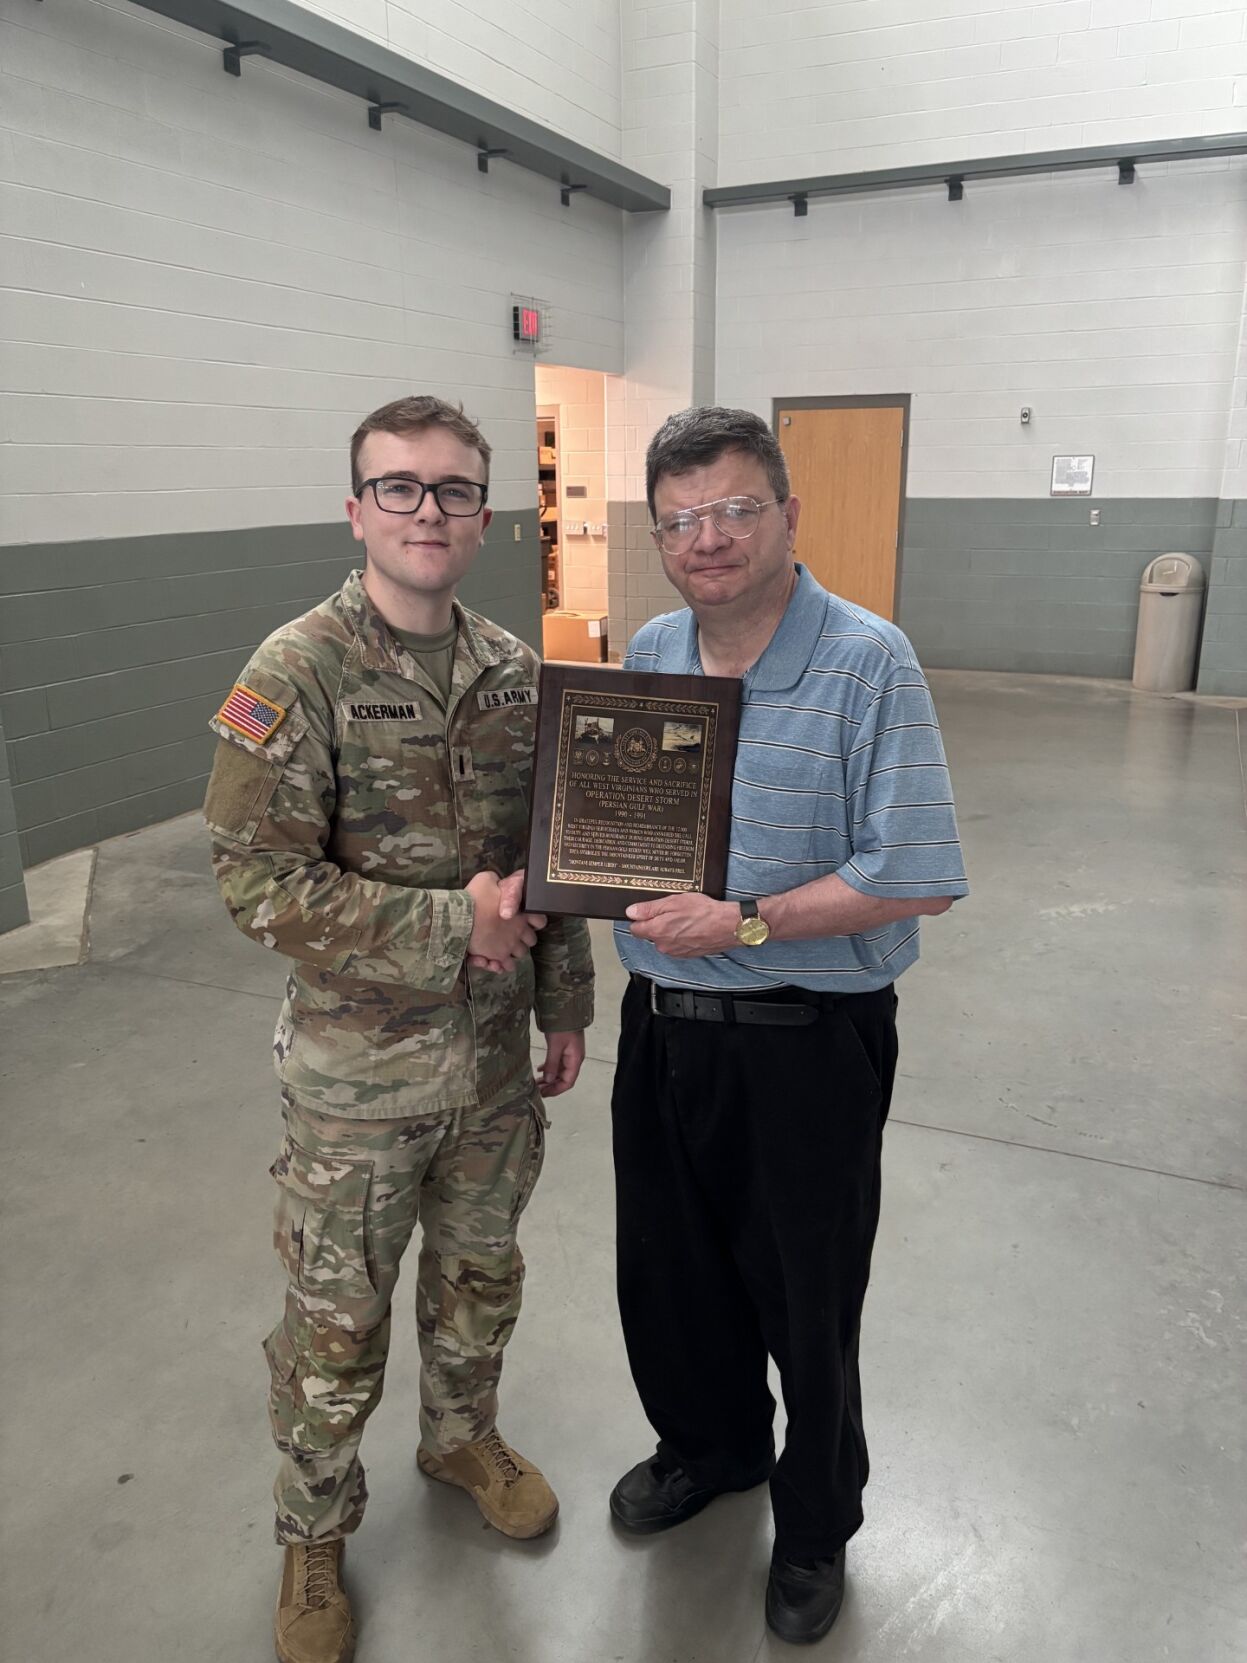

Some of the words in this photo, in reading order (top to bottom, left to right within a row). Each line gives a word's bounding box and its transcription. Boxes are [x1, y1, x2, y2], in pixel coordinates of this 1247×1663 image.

[350, 704, 416, 720] ACKERMAN
[569, 779, 577, 787] OF
[578, 780, 590, 788] ALL
[592, 781, 609, 789] WEST
[611, 783, 647, 793] VIRGINIANS
[648, 786, 664, 794] WHO
[665, 788, 688, 796] SERVED
[571, 771, 605, 781] HONORING
[607, 774, 619, 782] THE
[620, 775, 646, 784] SERVICE
[649, 778, 662, 786] AND
[663, 779, 696, 789] SACRIFICE
[585, 789, 625, 800] OPERATION
[627, 793, 653, 802] DESERT
[654, 795, 680, 805] STORM
[628, 802, 645, 810] GULF
